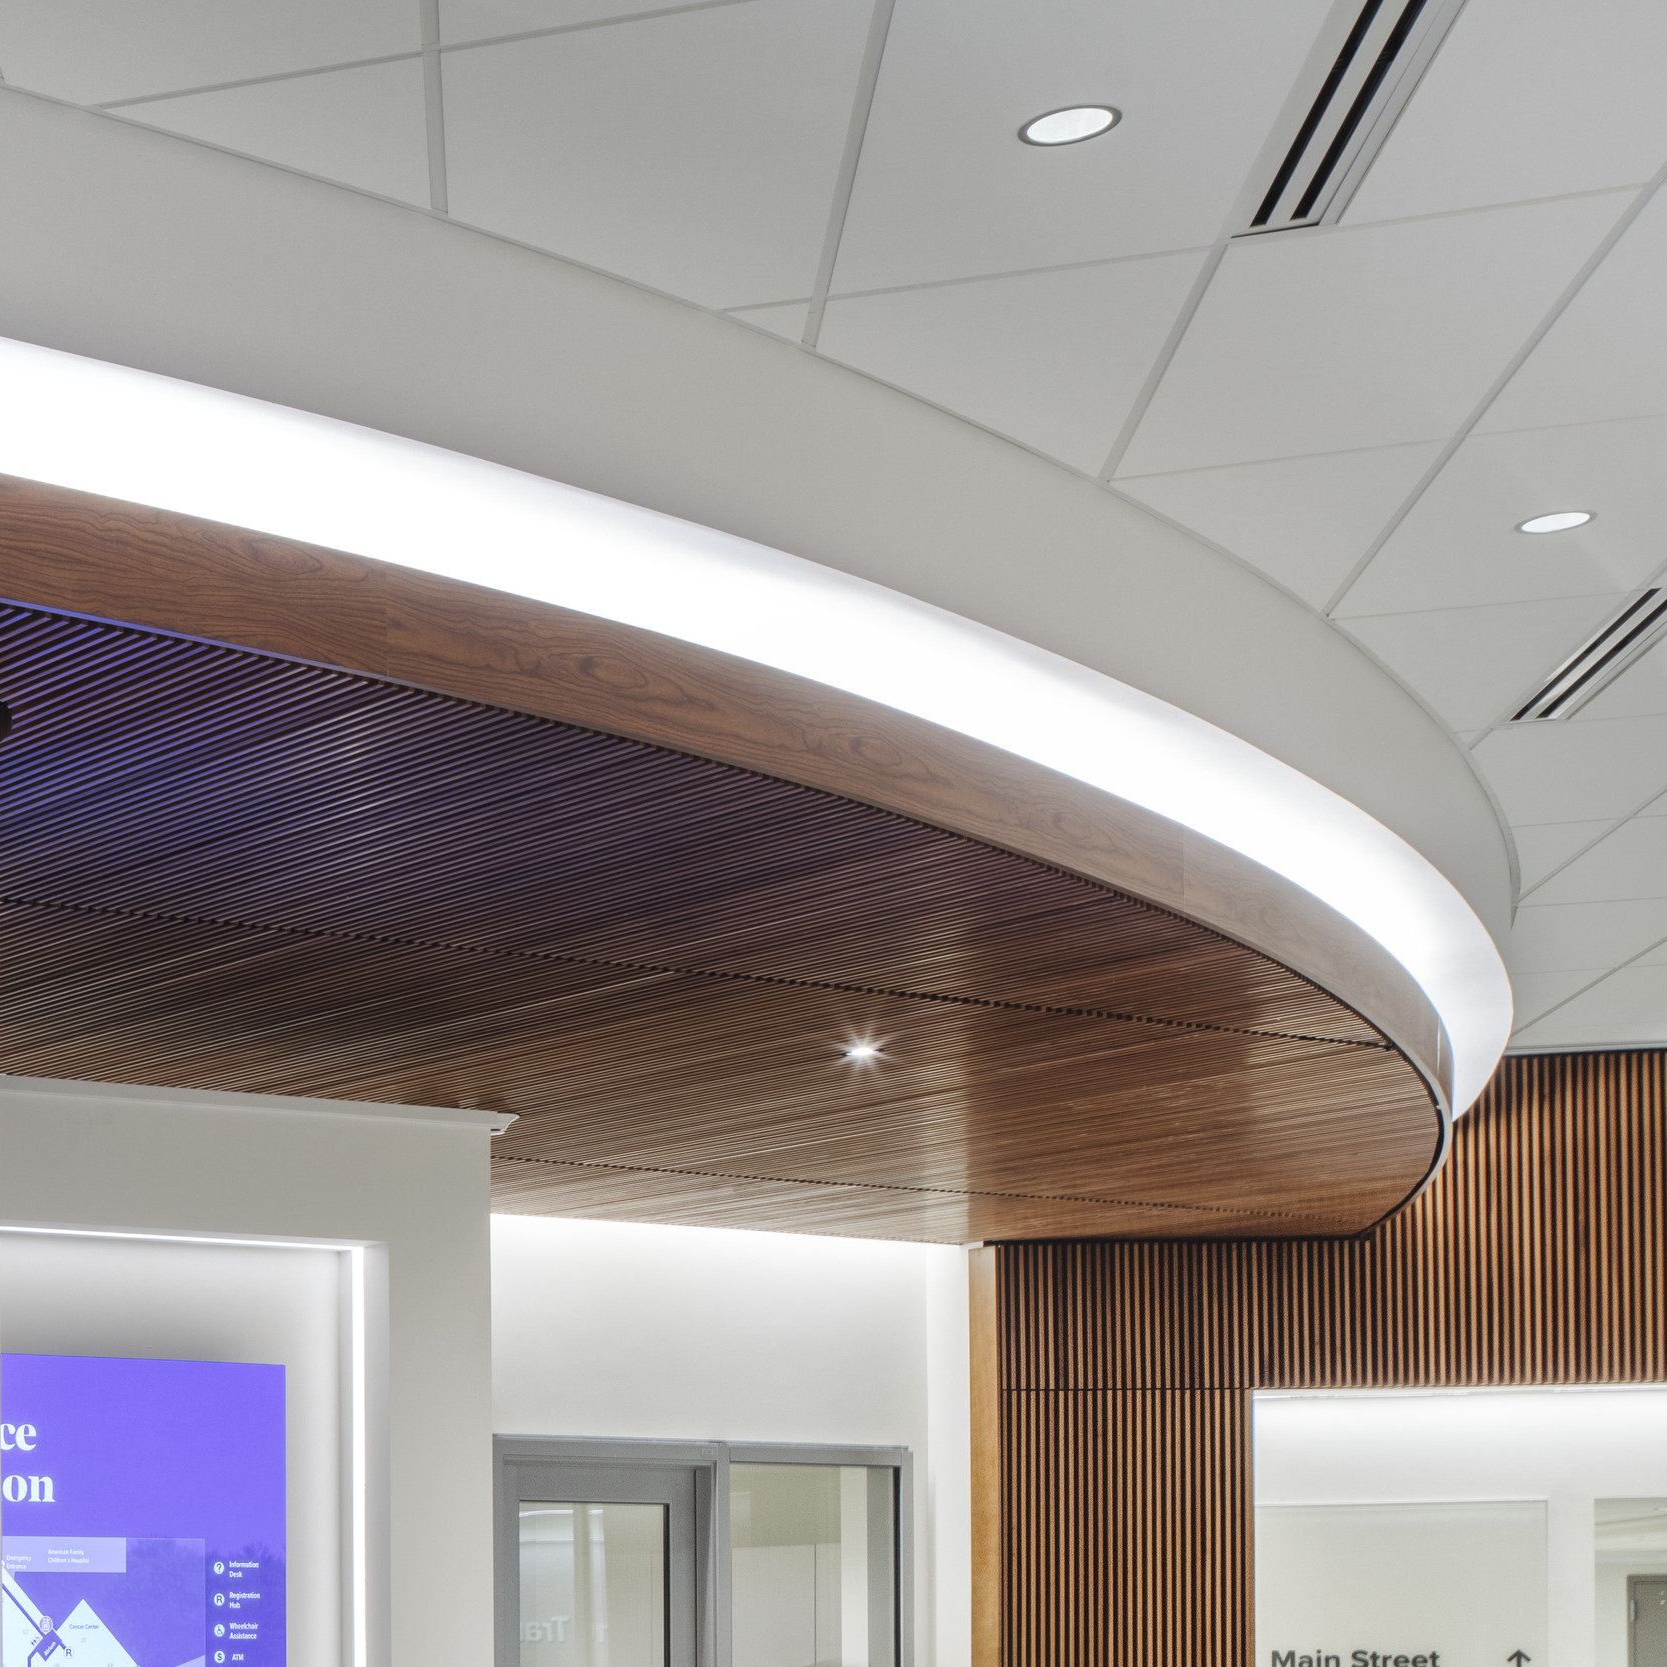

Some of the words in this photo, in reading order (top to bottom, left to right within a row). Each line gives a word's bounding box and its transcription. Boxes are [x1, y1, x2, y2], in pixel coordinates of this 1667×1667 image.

[0, 1423, 36, 1451] ce
[1, 1475, 56, 1502] on
[229, 1592, 260, 1600] Registration
